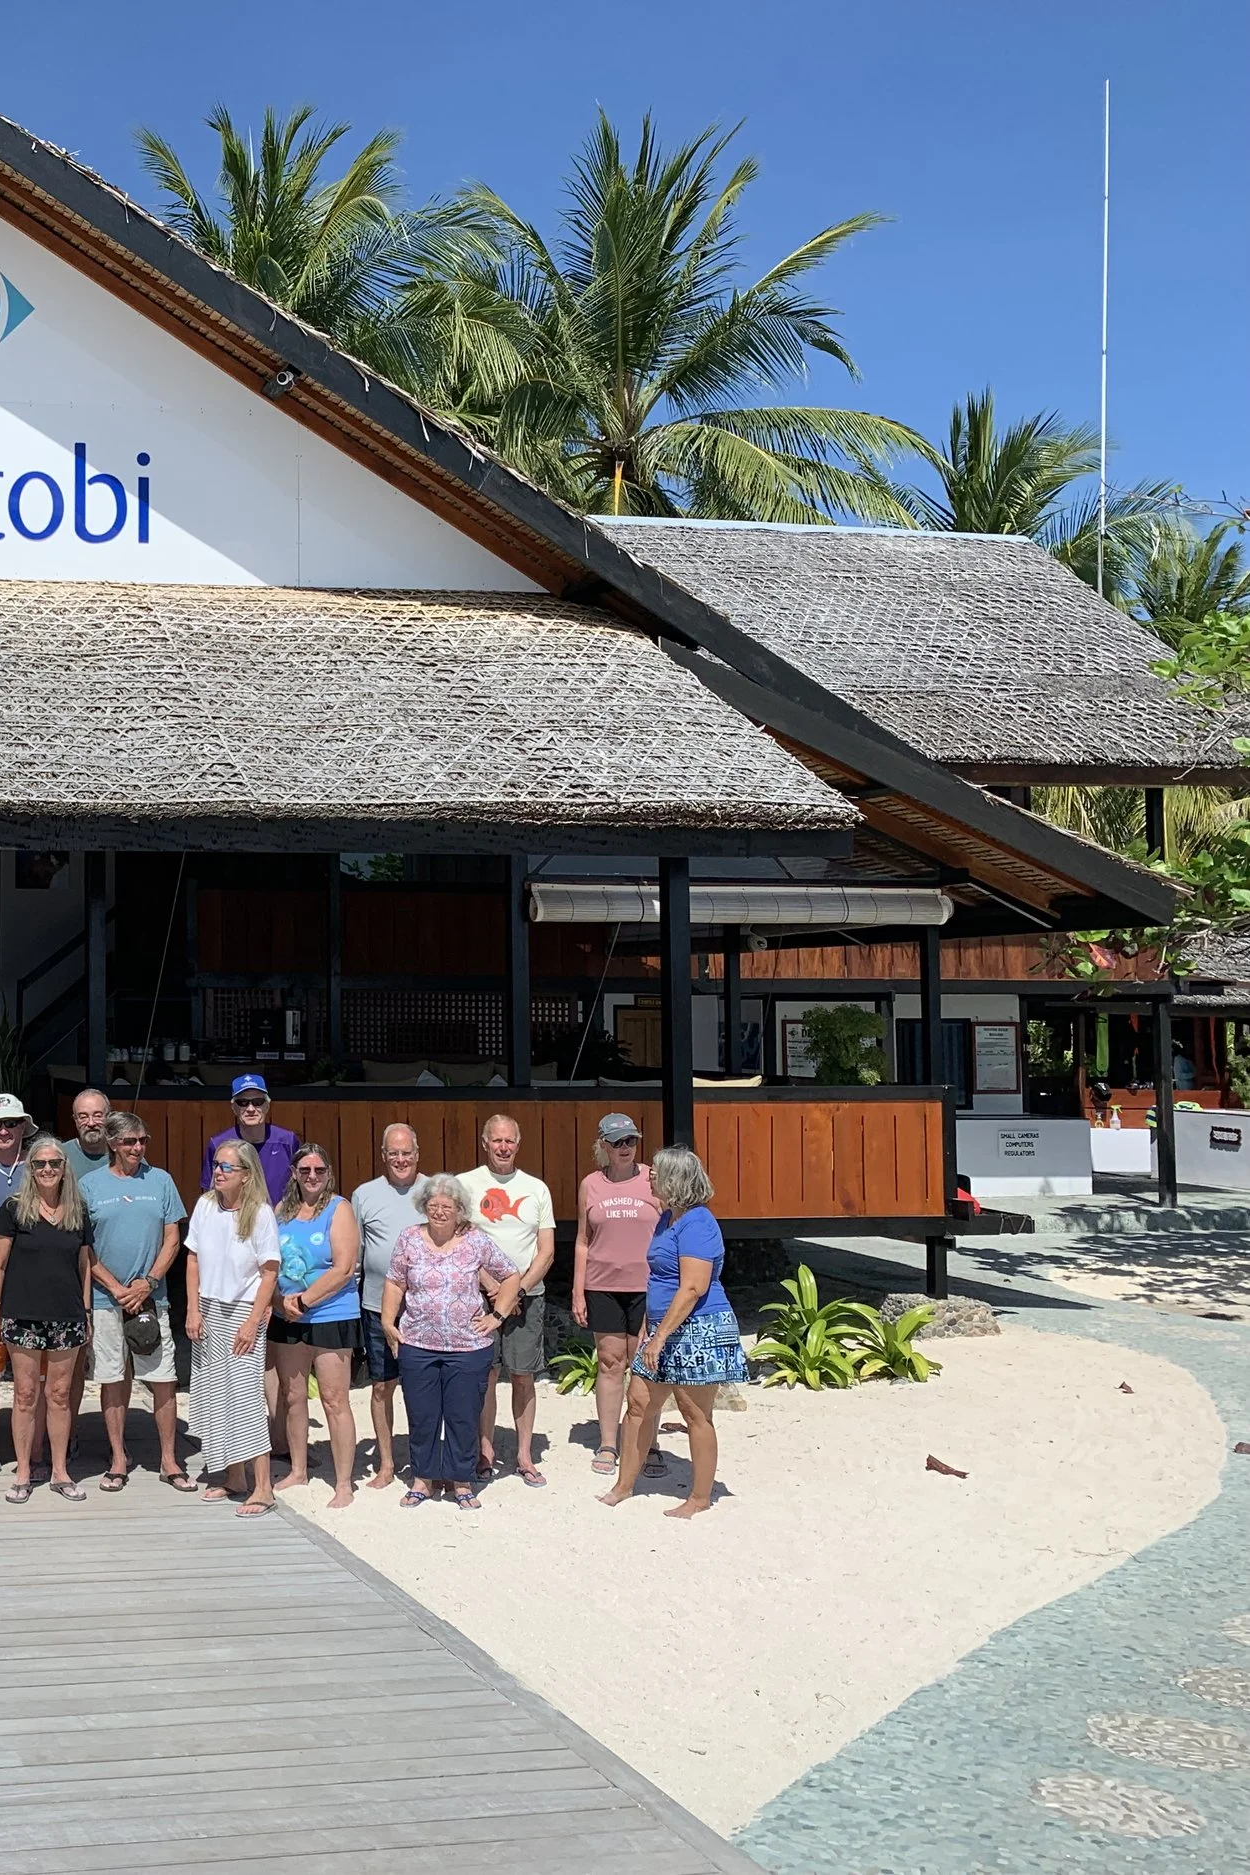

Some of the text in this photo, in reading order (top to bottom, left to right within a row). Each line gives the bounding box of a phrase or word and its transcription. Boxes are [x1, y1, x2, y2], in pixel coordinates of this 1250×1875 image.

[602, 1197, 633, 1208] WASHED
[633, 1199, 645, 1208] UP
[606, 1209, 638, 1219] LIKE THIS
